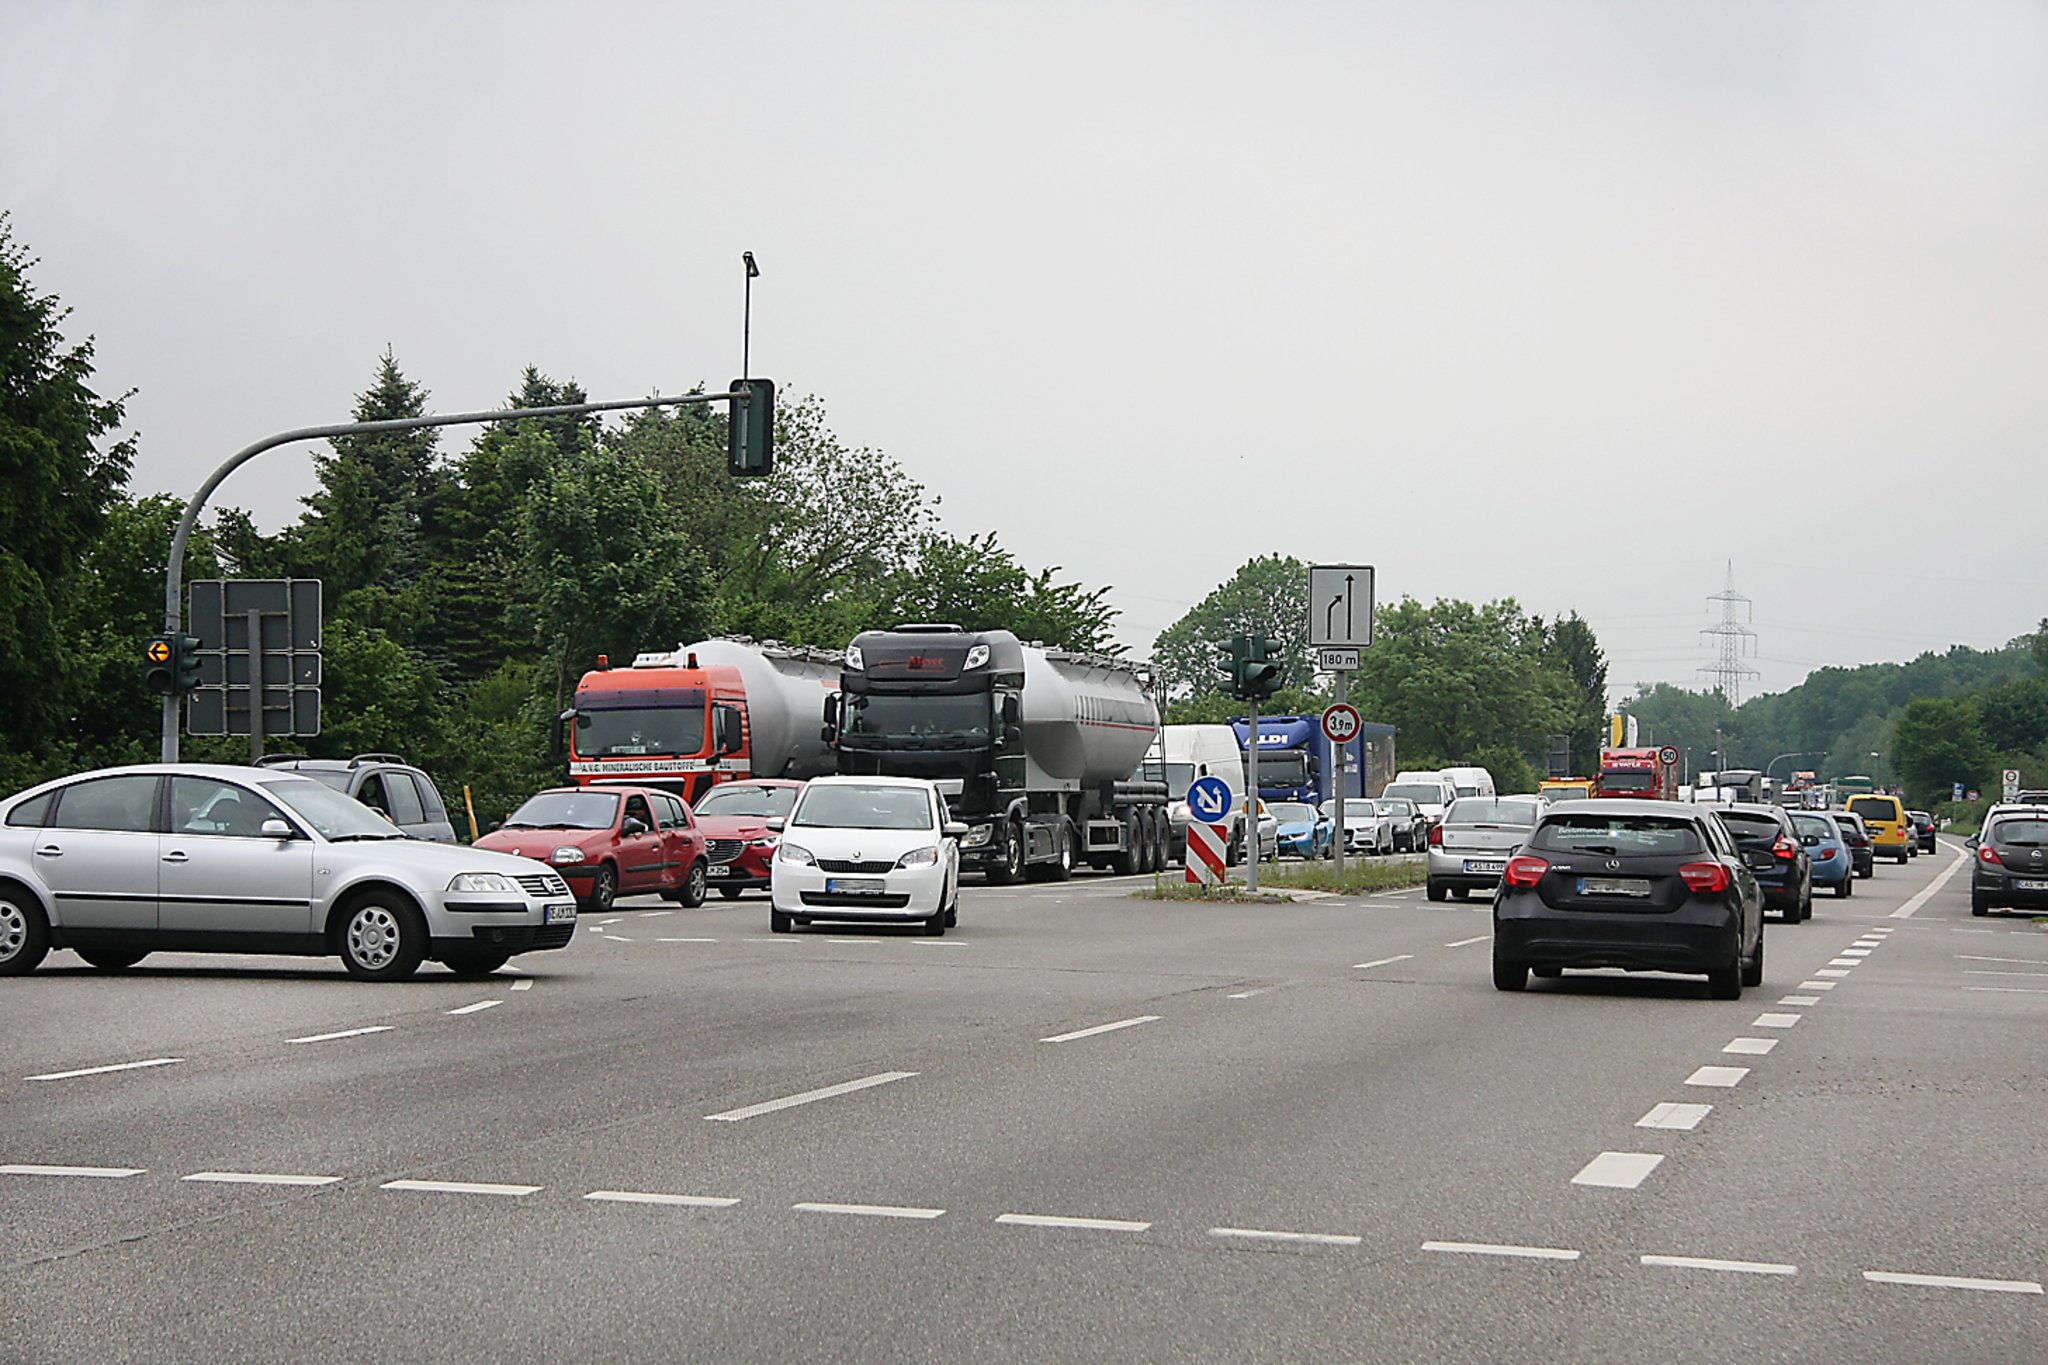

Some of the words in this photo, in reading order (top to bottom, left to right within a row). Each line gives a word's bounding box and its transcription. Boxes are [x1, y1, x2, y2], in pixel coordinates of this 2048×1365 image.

[1323, 654, 1342, 665] 180
[1345, 657, 1357, 665] m
[1663, 751, 1675, 761] 50
[602, 762, 652, 773] MINERALISCHE
[654, 760, 695, 772] BAUSTOFFE
